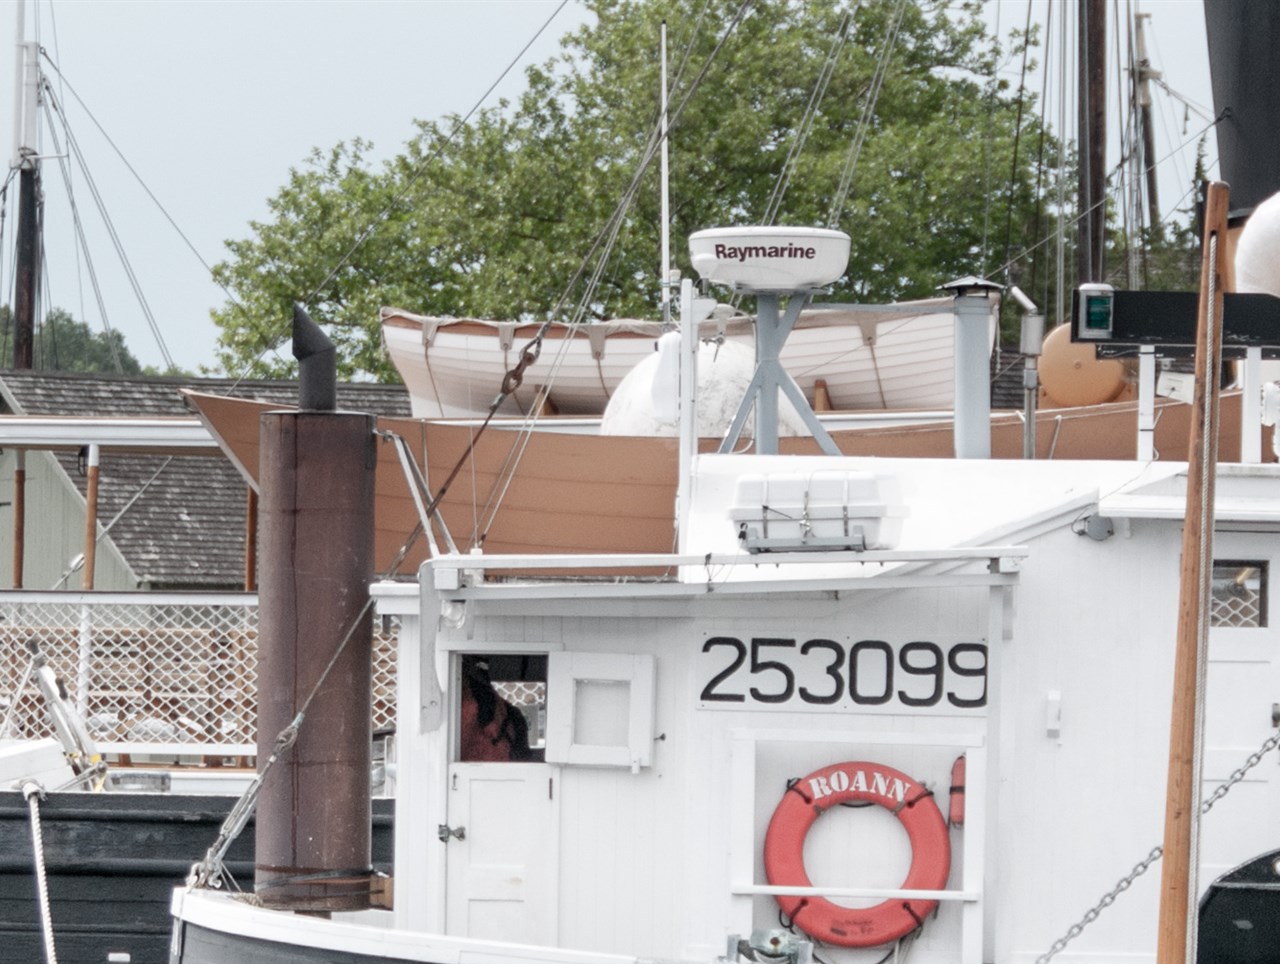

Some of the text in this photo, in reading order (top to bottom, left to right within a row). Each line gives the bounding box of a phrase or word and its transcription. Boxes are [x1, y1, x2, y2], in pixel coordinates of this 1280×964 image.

[715, 243, 816, 262] Raymarine
[700, 636, 988, 708] 253099
[809, 770, 911, 802] ROANN
